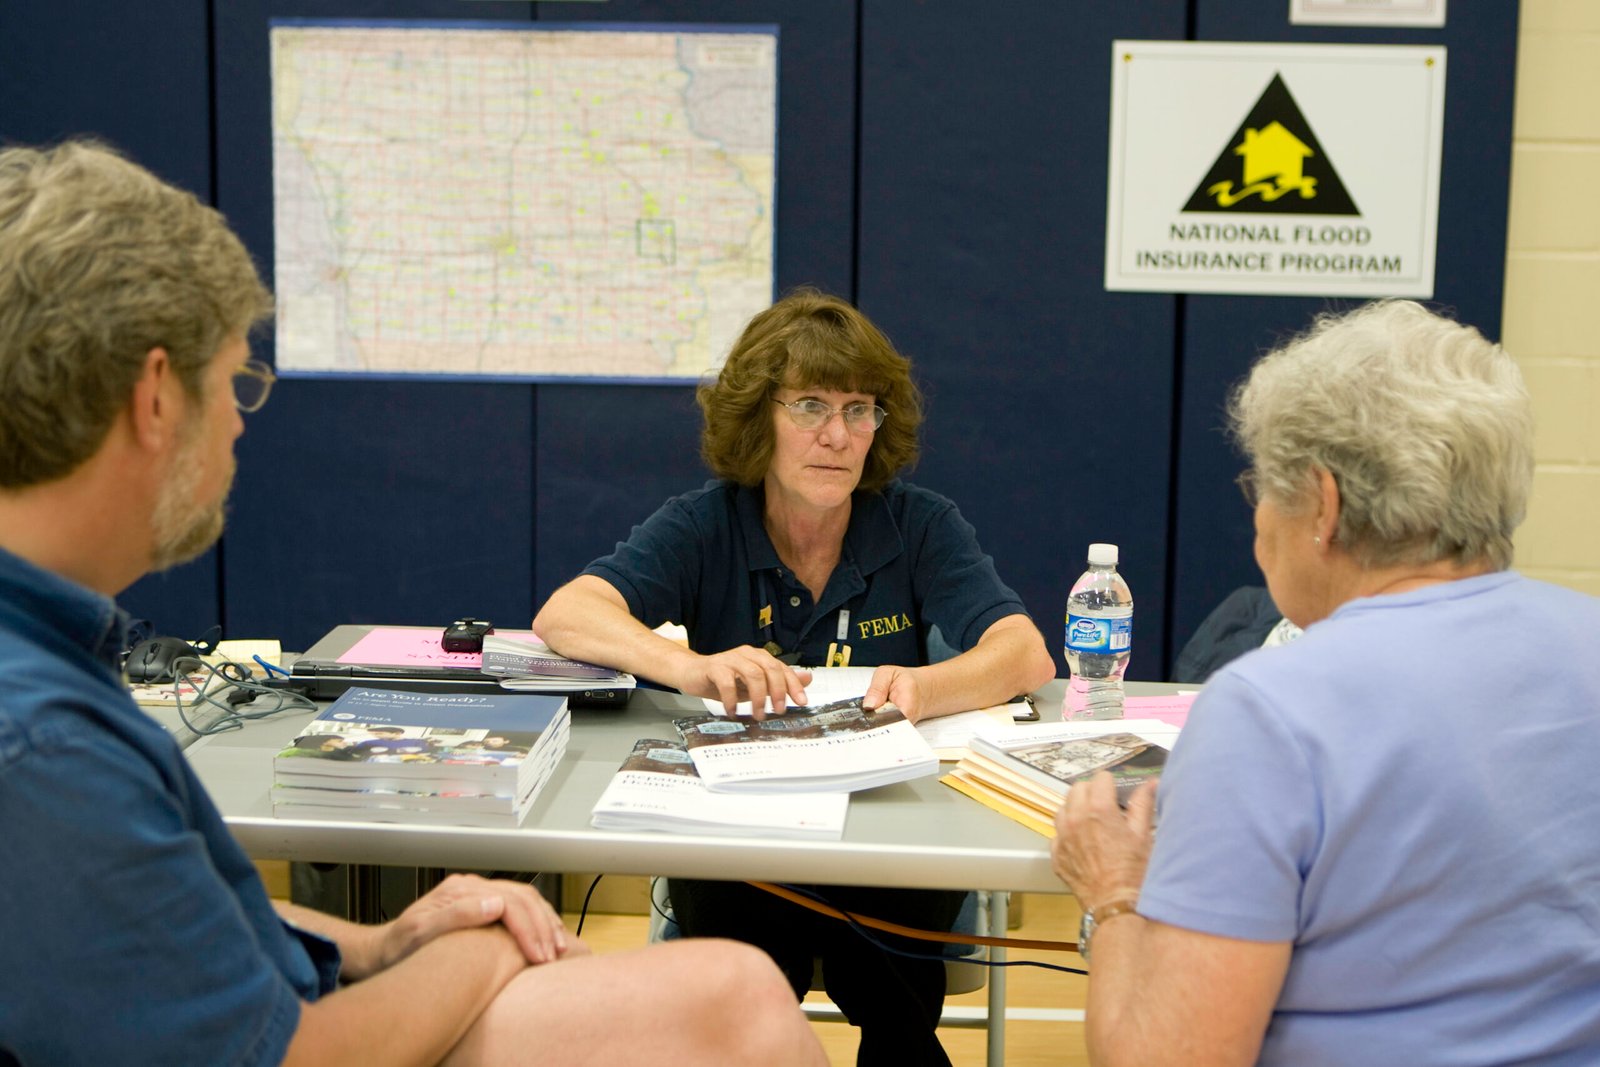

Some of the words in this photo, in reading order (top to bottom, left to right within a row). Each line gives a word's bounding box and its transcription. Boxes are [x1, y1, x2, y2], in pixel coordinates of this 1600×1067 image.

[1170, 223, 1284, 243] NATIONAL
[1294, 226, 1371, 246] FLOOD
[1136, 249, 1274, 271] INSURANCE
[1280, 252, 1403, 273] PROGRAM
[857, 613, 913, 639] FEMA
[392, 693, 421, 701] You
[426, 696, 487, 704] Ready?
